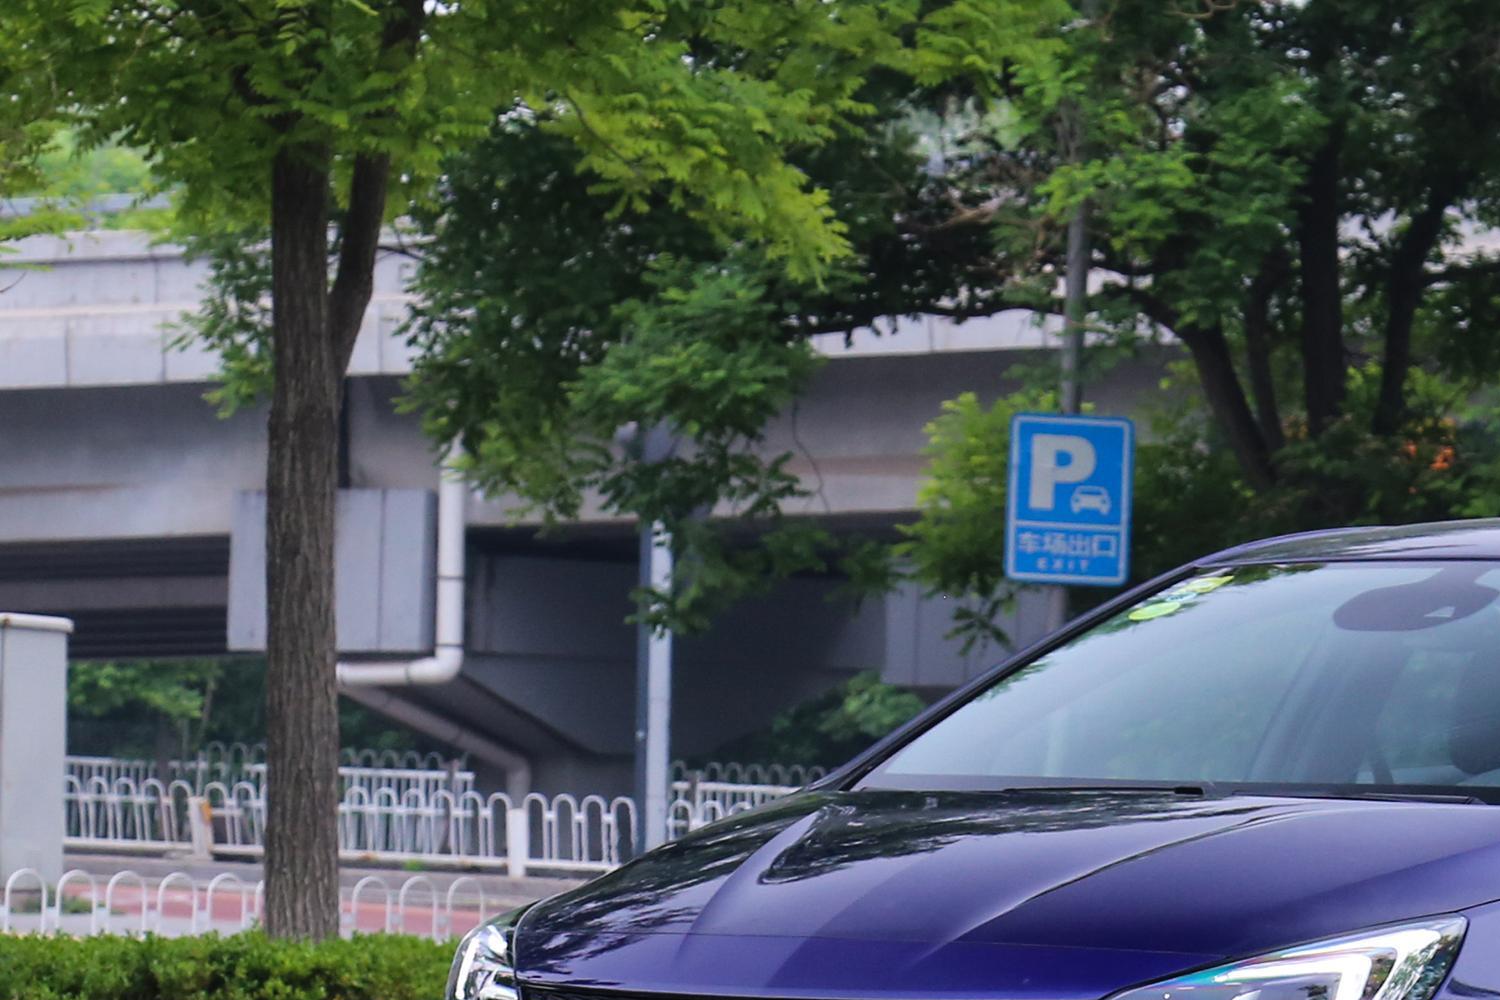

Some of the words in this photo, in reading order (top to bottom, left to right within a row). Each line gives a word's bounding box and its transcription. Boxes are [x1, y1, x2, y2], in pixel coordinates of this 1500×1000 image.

[1028, 433, 1096, 510] P
[1018, 531, 1117, 557] 车场出口
